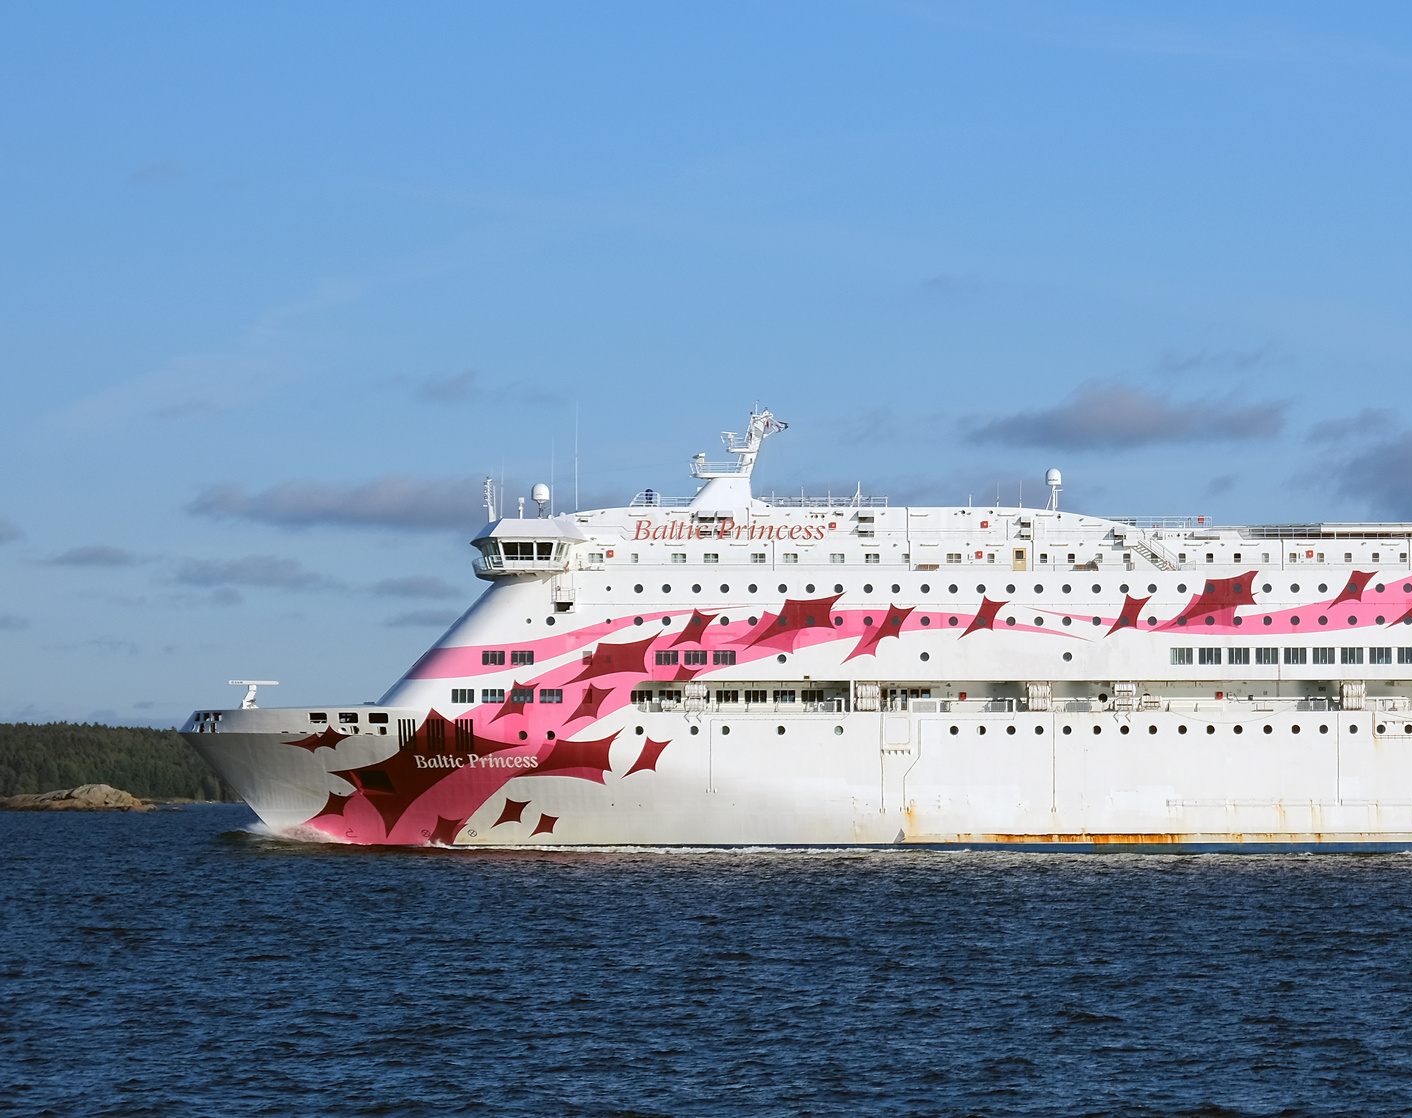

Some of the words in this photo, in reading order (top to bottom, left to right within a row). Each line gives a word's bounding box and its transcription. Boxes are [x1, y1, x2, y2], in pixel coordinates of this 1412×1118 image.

[632, 519, 709, 541] Baltic
[716, 518, 826, 541] Princess
[413, 754, 465, 769] Baltic
[466, 753, 539, 769] Princess
